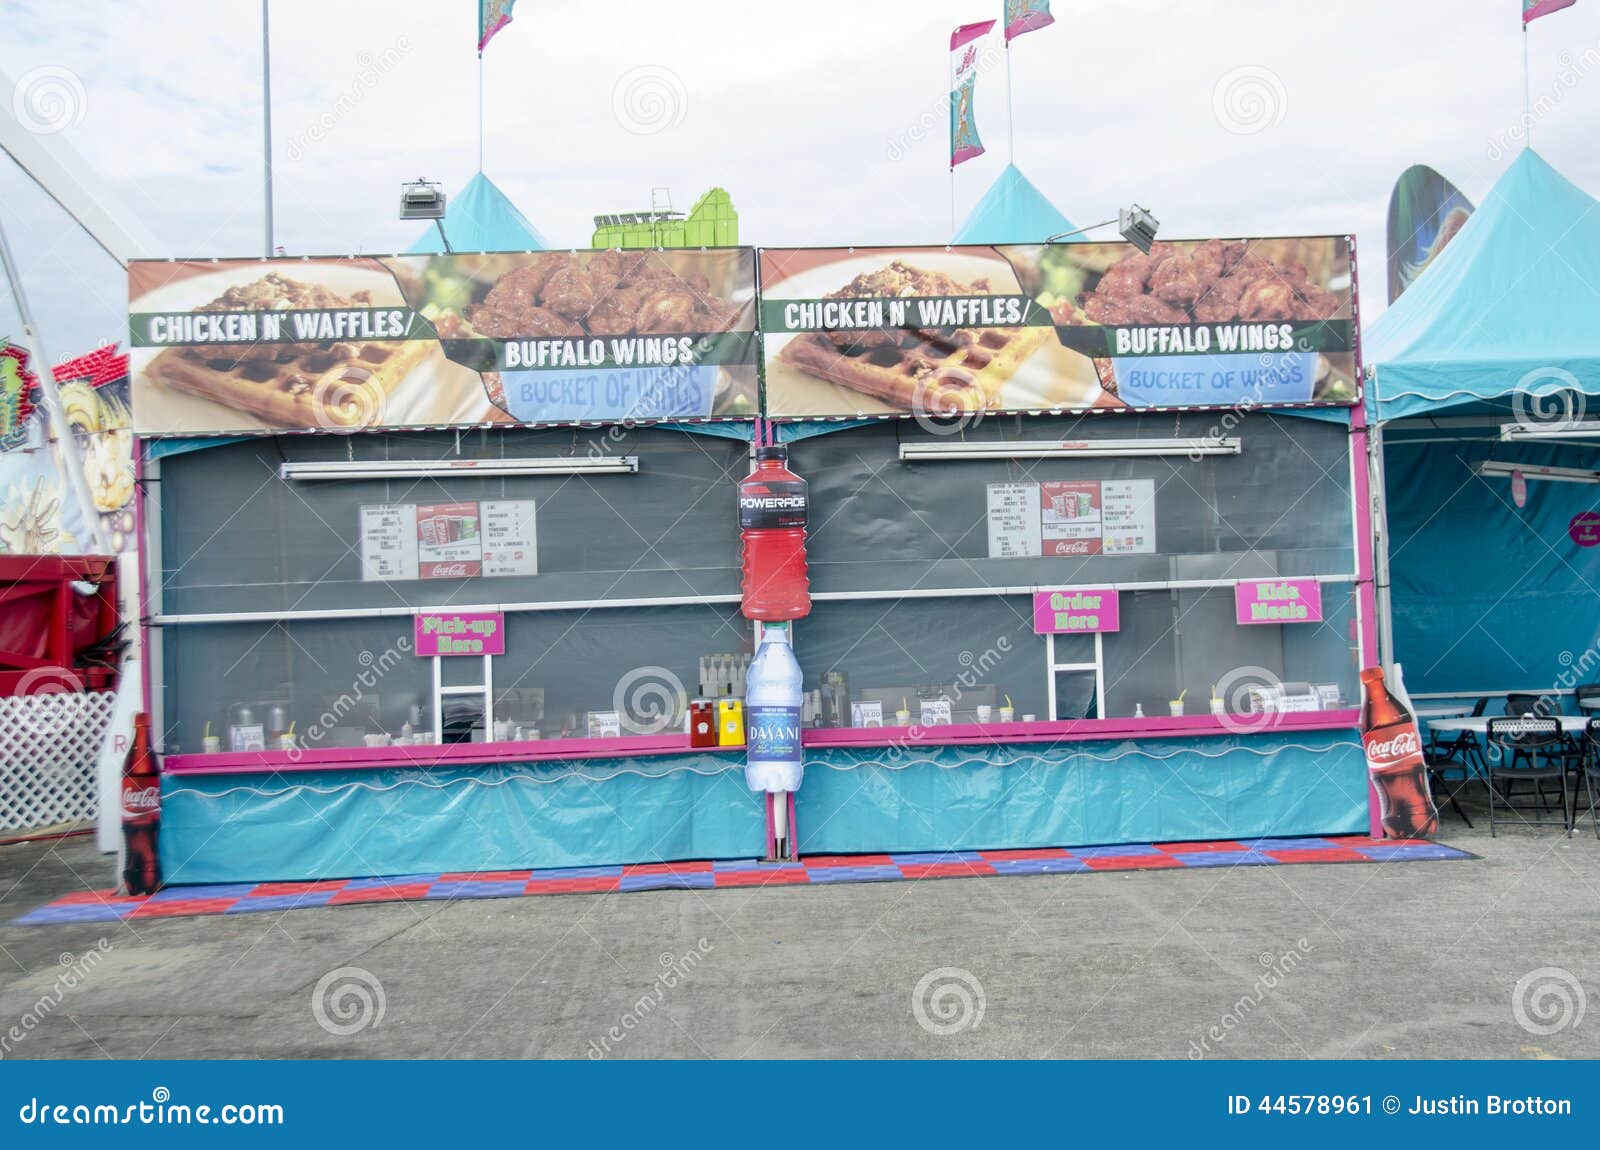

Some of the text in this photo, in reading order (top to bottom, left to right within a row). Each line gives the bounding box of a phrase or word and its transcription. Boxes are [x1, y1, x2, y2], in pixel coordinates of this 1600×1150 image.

[784, 301, 883, 329] CHICKEN
[889, 301, 911, 328] N'
[151, 314, 257, 342] CHICKEN
[263, 313, 287, 340] N'
[1116, 324, 1294, 354] BUFFALO WINGS
[505, 337, 693, 367] BUFFALO WINGS
[1129, 365, 1303, 390] BUCKET OF WINGS
[521, 374, 599, 406] BUCKET
[606, 371, 631, 408] OF
[740, 497, 805, 509] POWERADE
[1050, 592, 1102, 611] Order
[1256, 582, 1299, 601] Kids
[1054, 612, 1099, 630] Here
[1251, 601, 1307, 620] Meals
[422, 616, 497, 637] Pick-up
[438, 635, 483, 653] Here
[750, 722, 799, 740] DASANI
[1367, 732, 1417, 760] Coca-Cola
